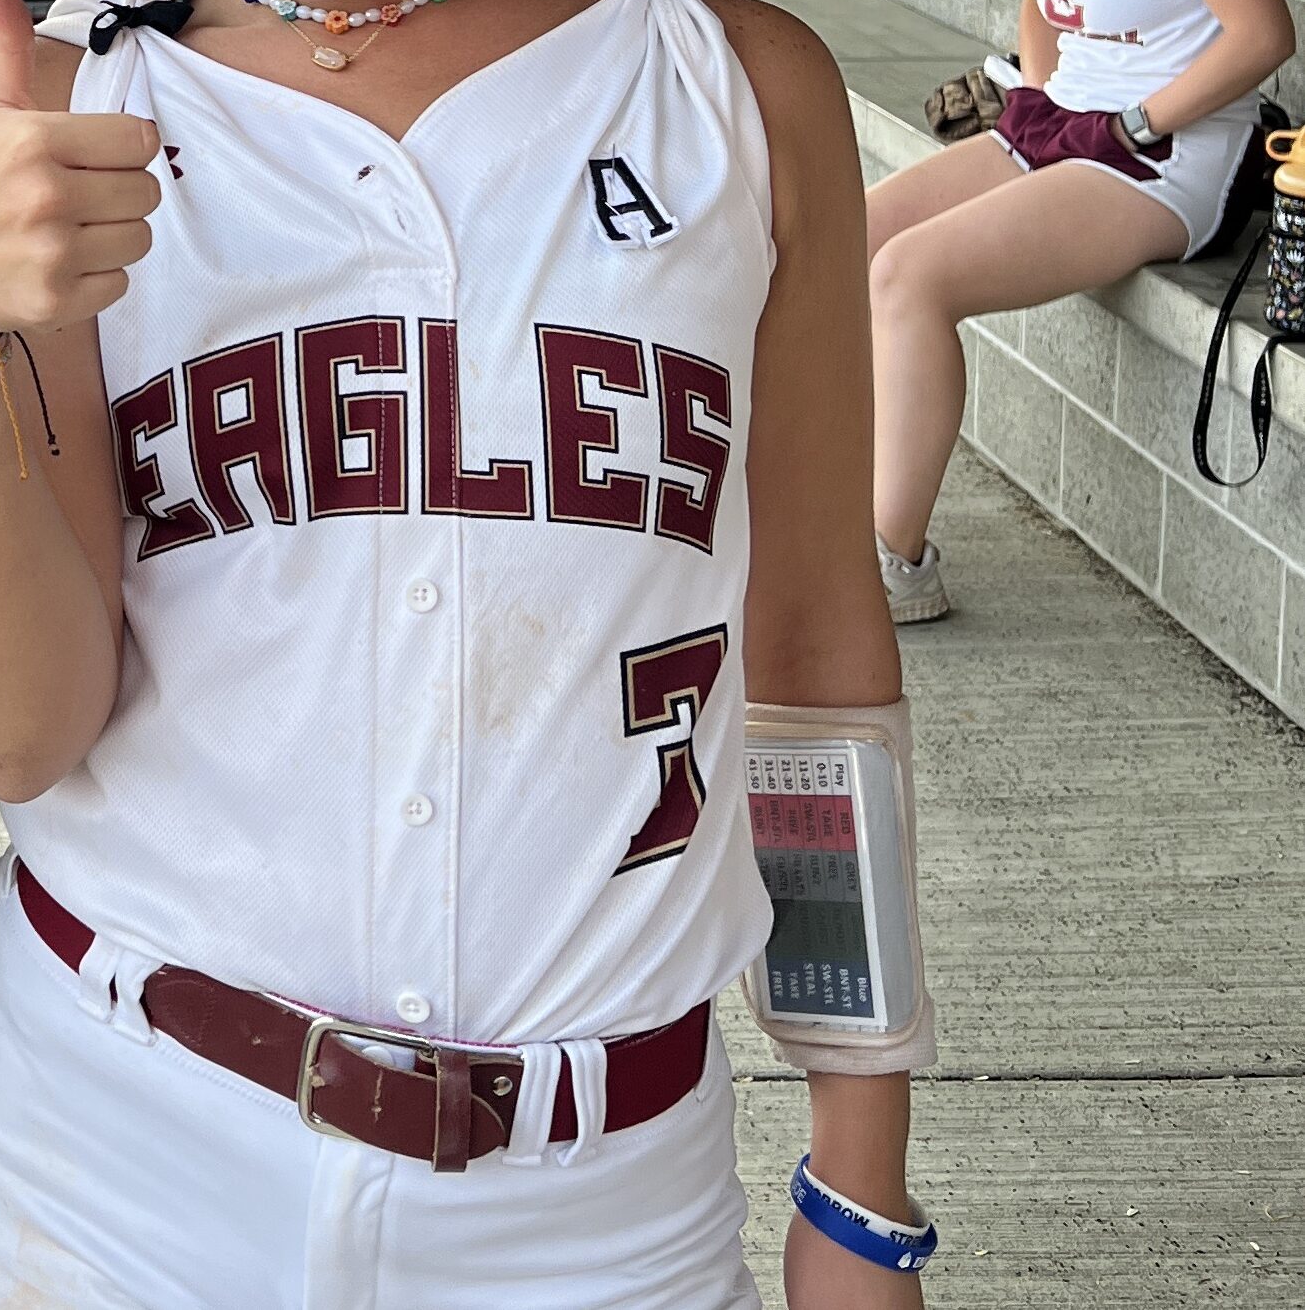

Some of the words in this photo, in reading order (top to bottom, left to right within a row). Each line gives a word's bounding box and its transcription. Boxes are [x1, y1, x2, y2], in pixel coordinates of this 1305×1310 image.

[588, 156, 673, 241] A
[111, 315, 731, 561] EAGLES
[612, 623, 727, 877] 7
[834, 763, 845, 787] Play
